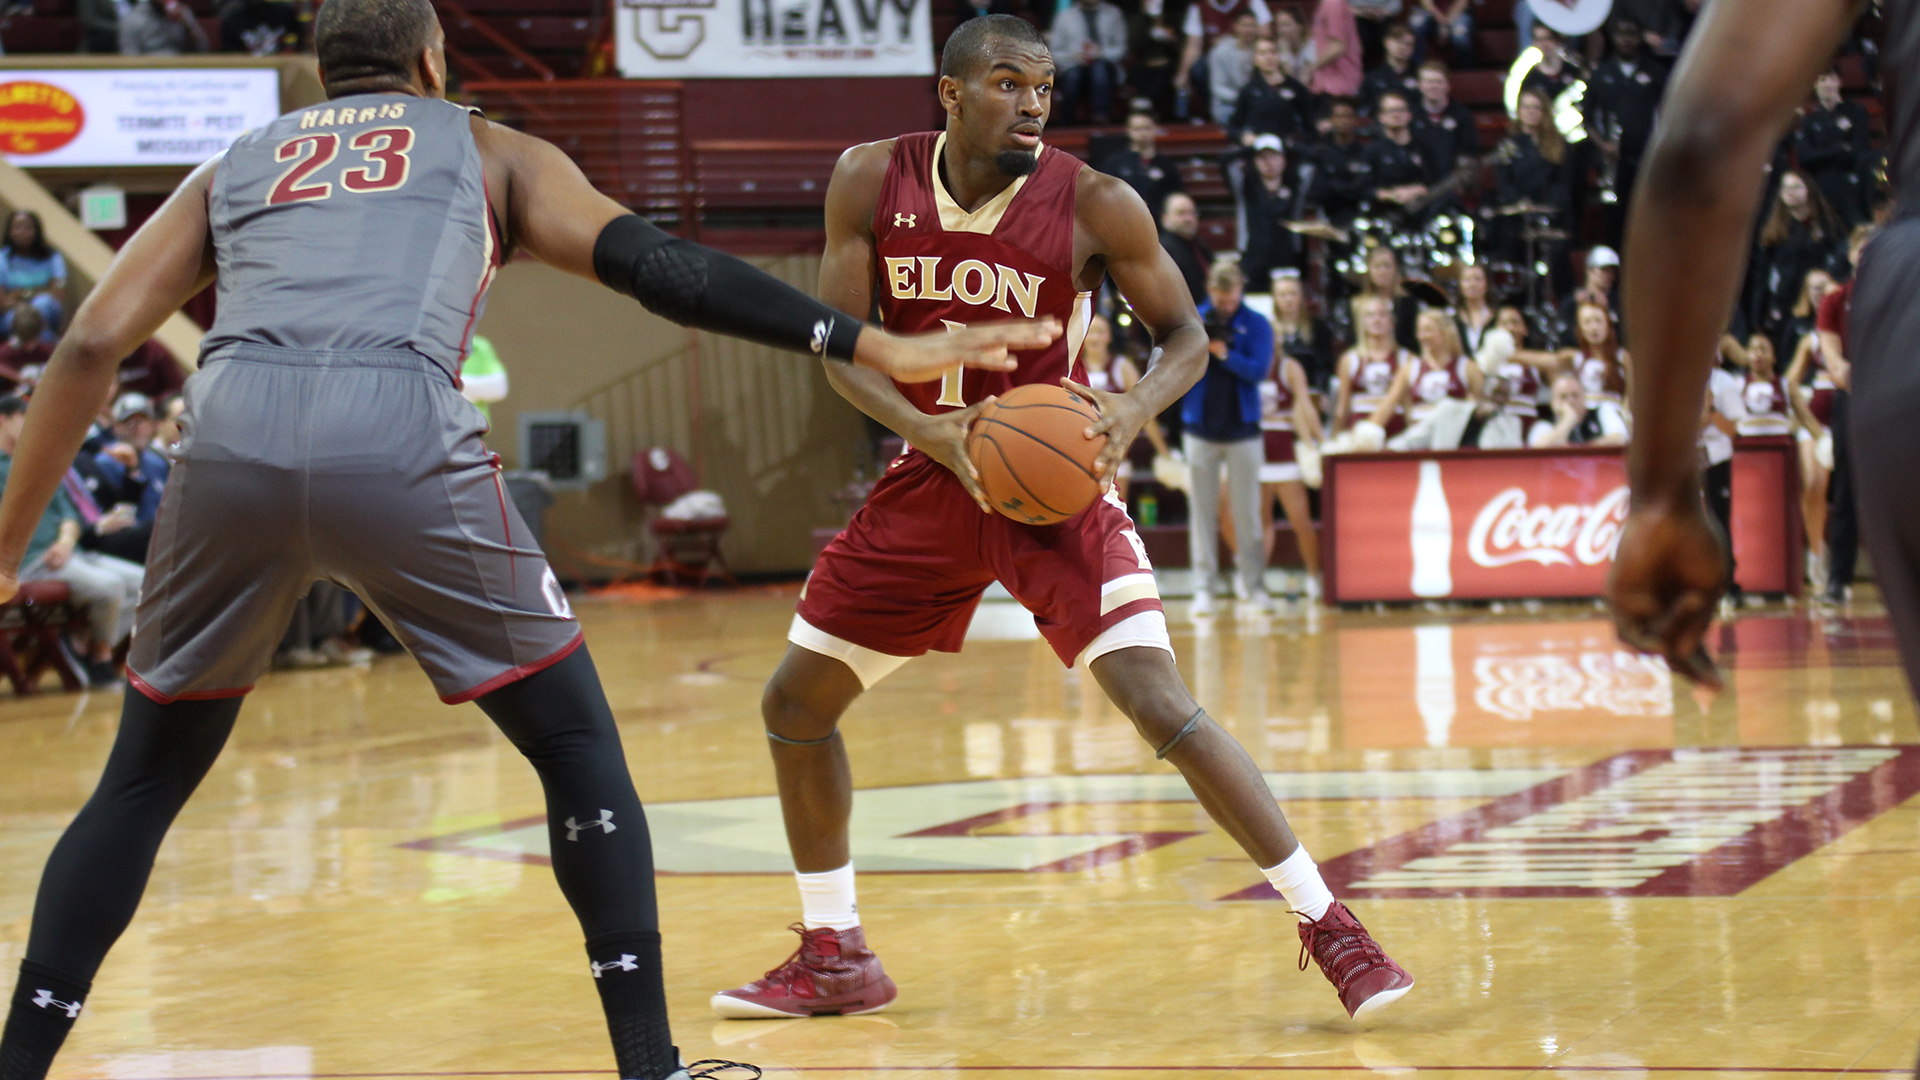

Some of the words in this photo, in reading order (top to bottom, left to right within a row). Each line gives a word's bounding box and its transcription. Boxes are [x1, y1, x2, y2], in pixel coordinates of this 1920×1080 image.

[742, 0, 918, 44] HEAVY
[301, 102, 406, 130] HARRIS
[264, 125, 415, 207] 23
[884, 256, 1047, 318] ELON
